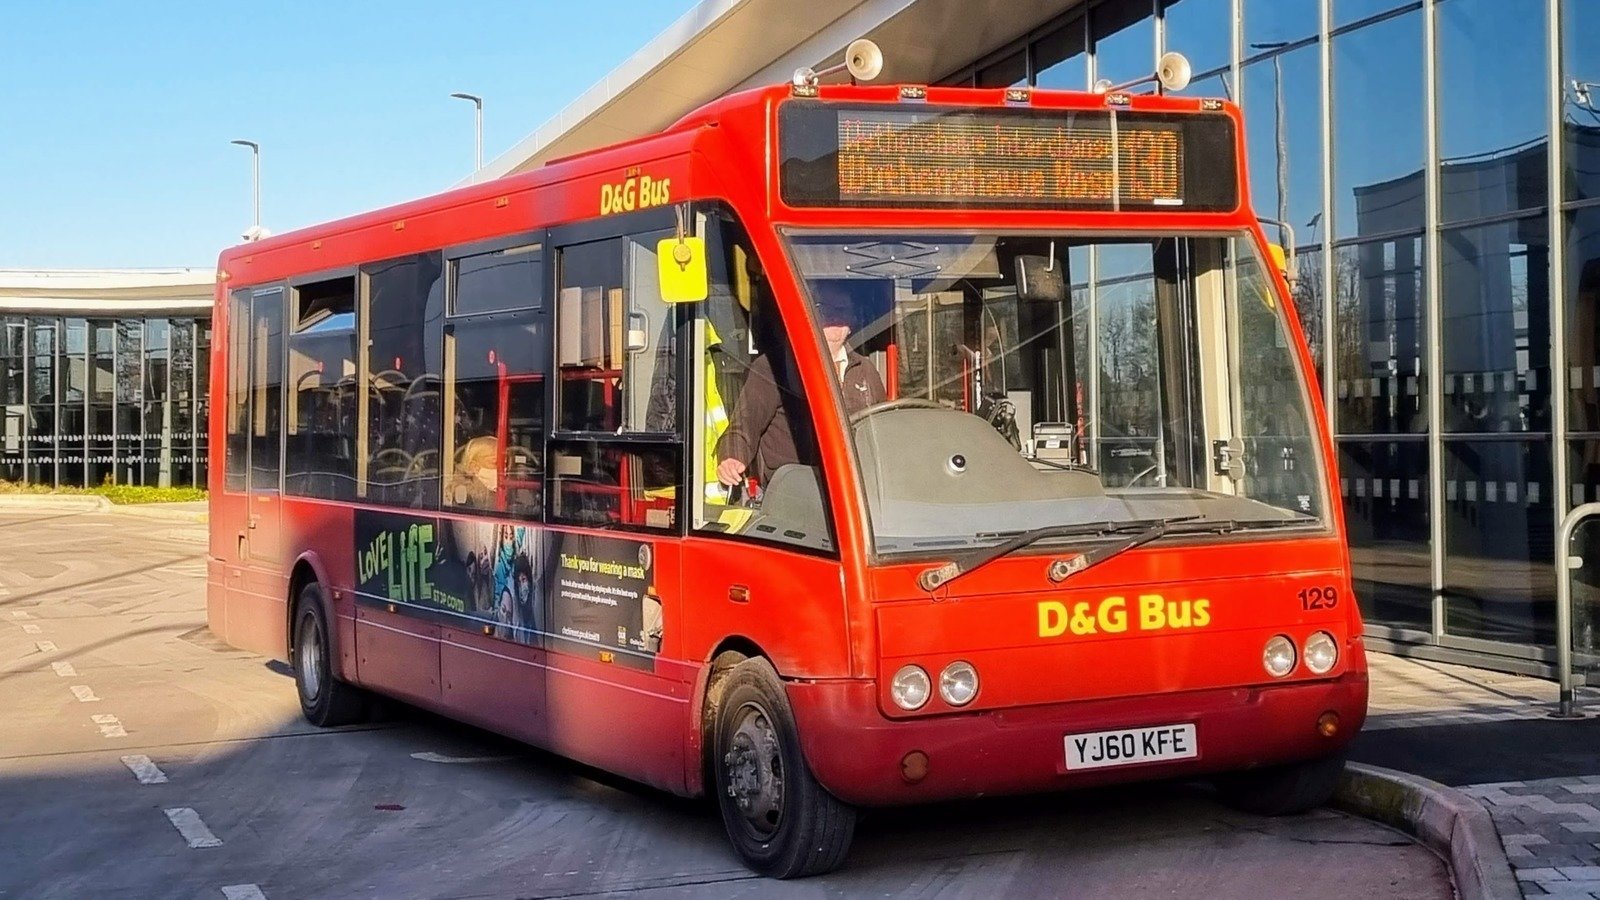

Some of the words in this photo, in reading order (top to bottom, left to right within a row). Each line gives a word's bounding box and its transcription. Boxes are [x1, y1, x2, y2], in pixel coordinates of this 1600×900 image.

[1122, 128, 1178, 201] 130
[600, 178, 636, 216] D&G
[639, 175, 670, 208] Bus
[560, 554, 578, 569] Thank
[578, 559, 589, 574] you
[589, 557, 599, 573] for
[599, 561, 623, 579] wearing
[627, 566, 645, 580] mask
[1037, 597, 1128, 638] D&G
[1139, 594, 1211, 630] Bus
[1298, 587, 1338, 611] 129
[1074, 733, 1136, 764] YJ60
[1141, 728, 1187, 757] KFE
